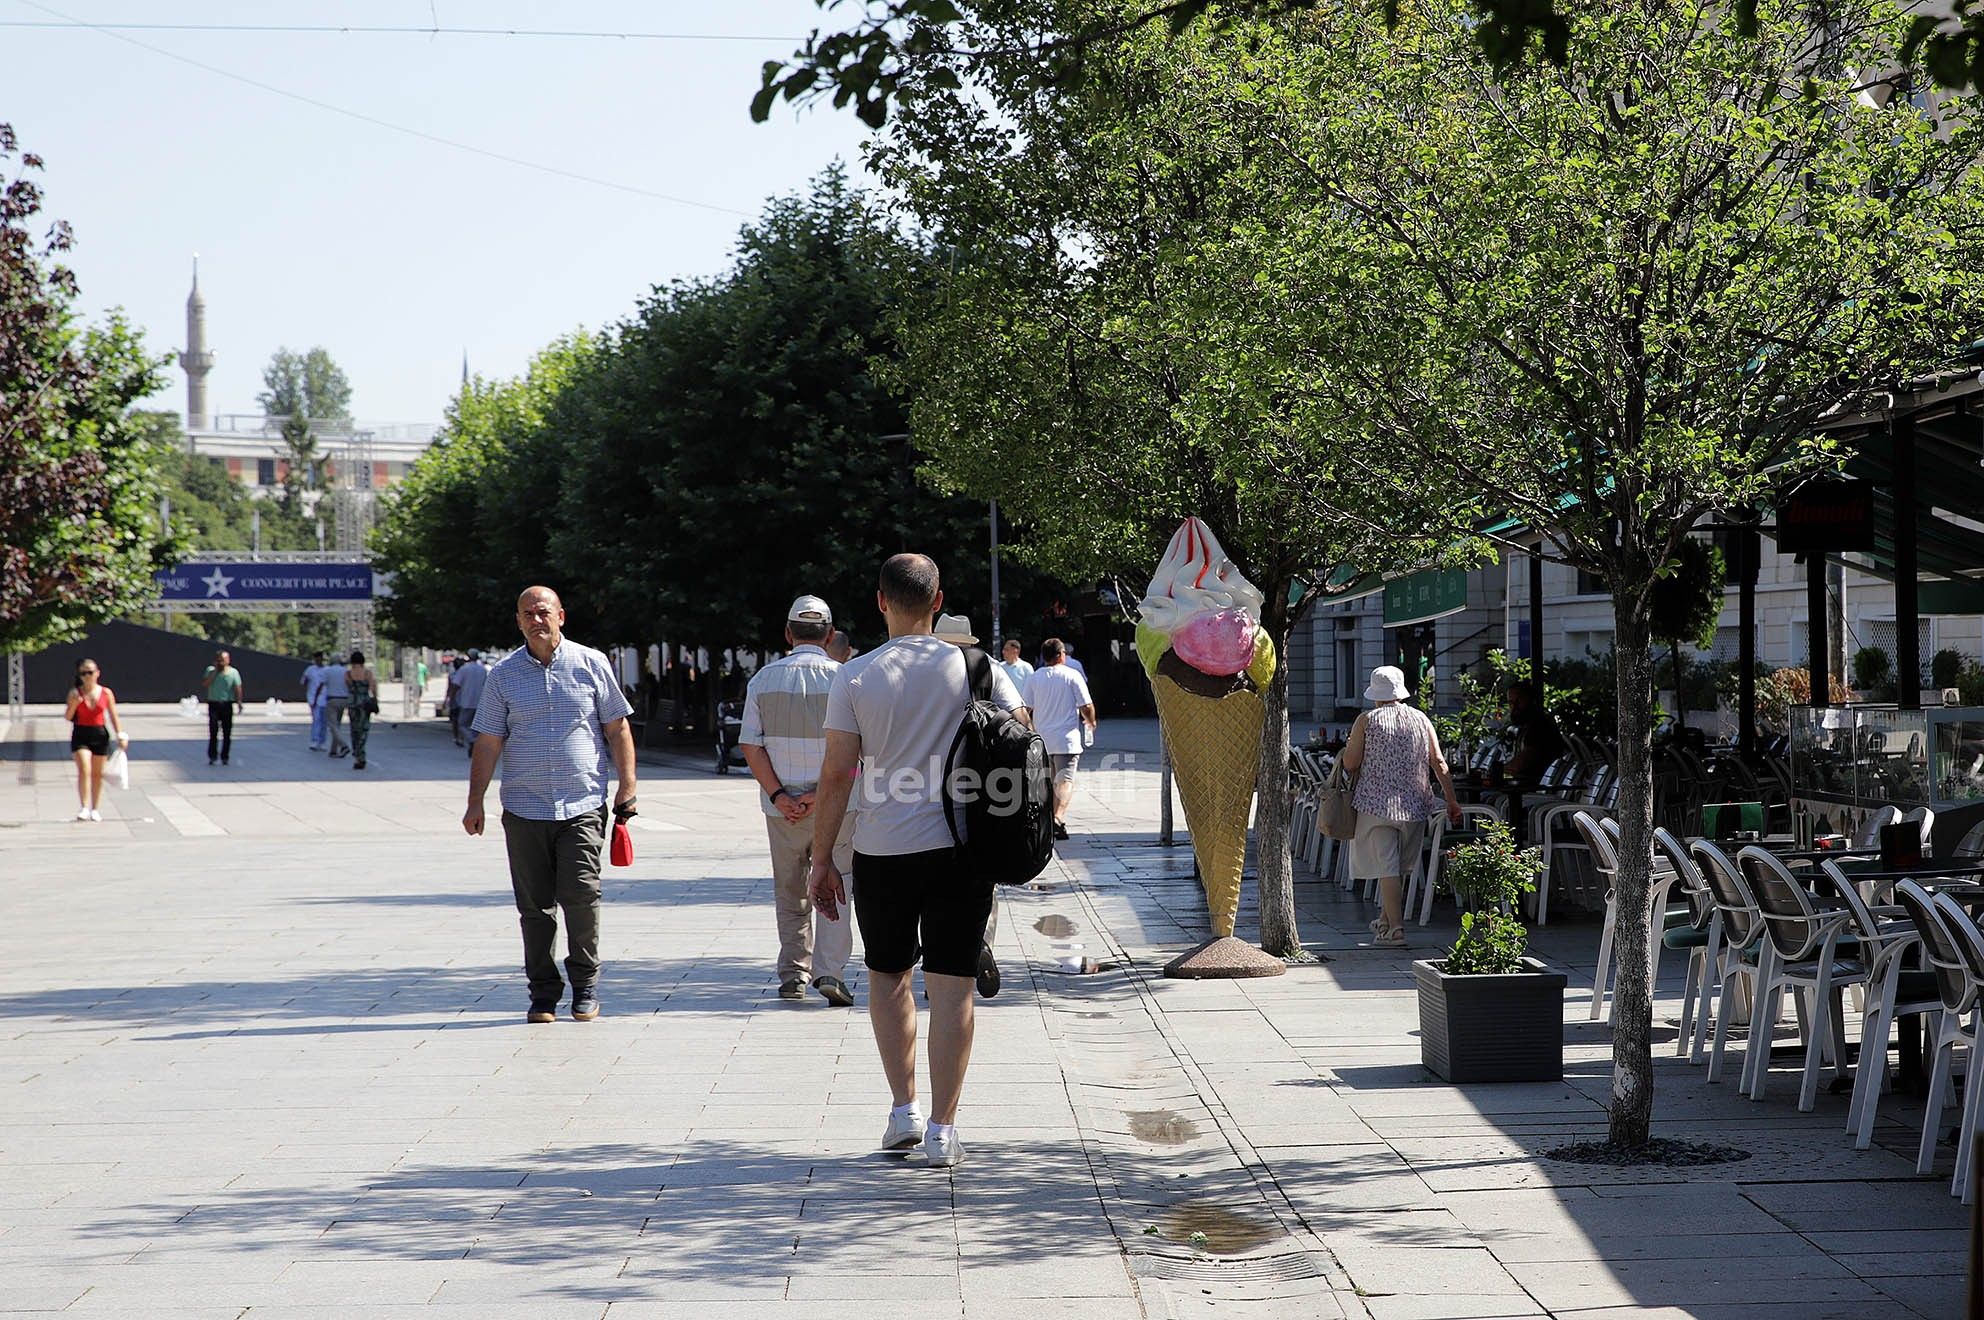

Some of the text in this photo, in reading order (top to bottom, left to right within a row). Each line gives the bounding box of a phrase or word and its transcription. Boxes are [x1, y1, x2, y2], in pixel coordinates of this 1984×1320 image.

[240, 577, 368, 590] CONCERT FOR PEACE
